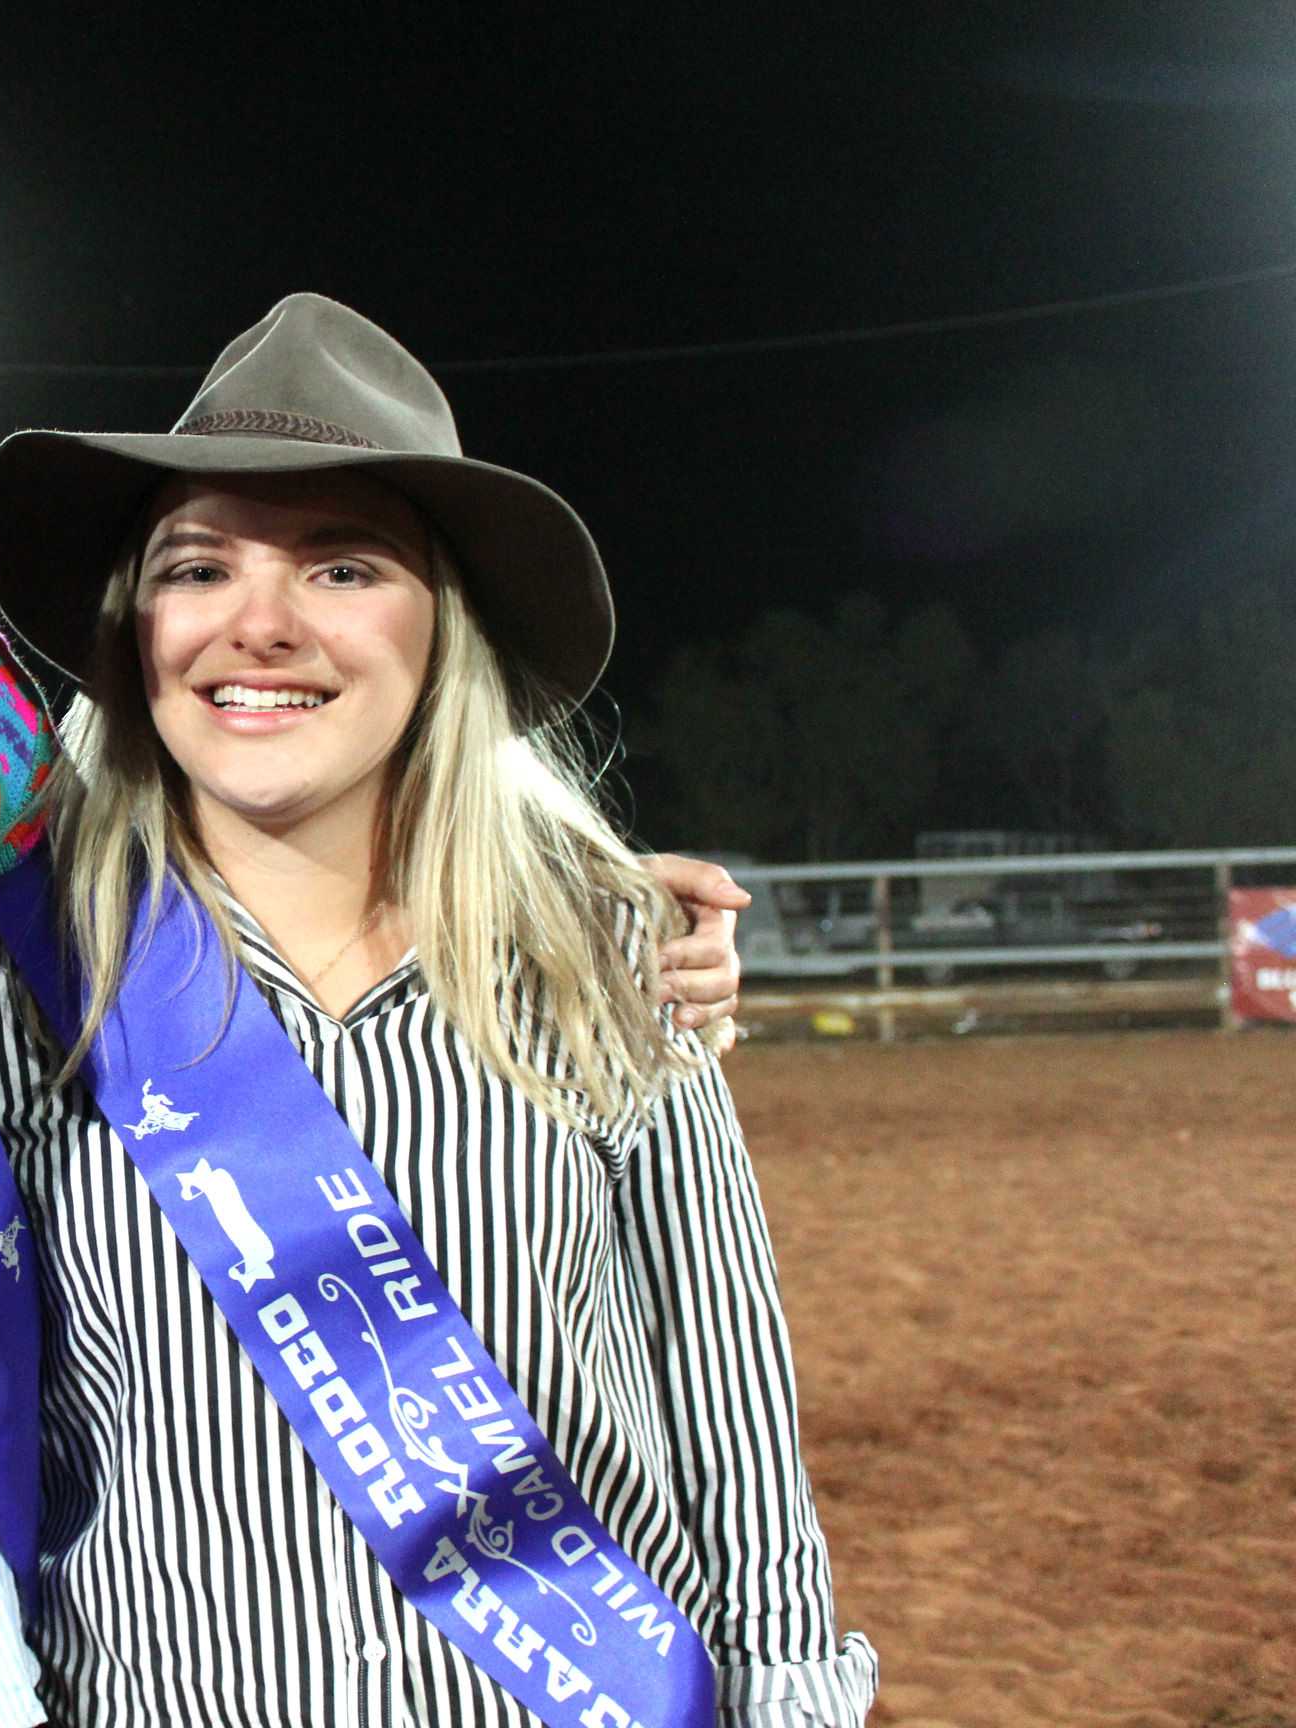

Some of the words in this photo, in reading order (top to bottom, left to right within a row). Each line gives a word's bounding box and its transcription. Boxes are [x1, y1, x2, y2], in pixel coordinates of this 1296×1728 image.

[316, 1168, 438, 1321] RIDE
[259, 1293, 427, 1529] RODEO
[431, 1337, 564, 1520] CAMEL
[552, 1526, 677, 1656] WILD
